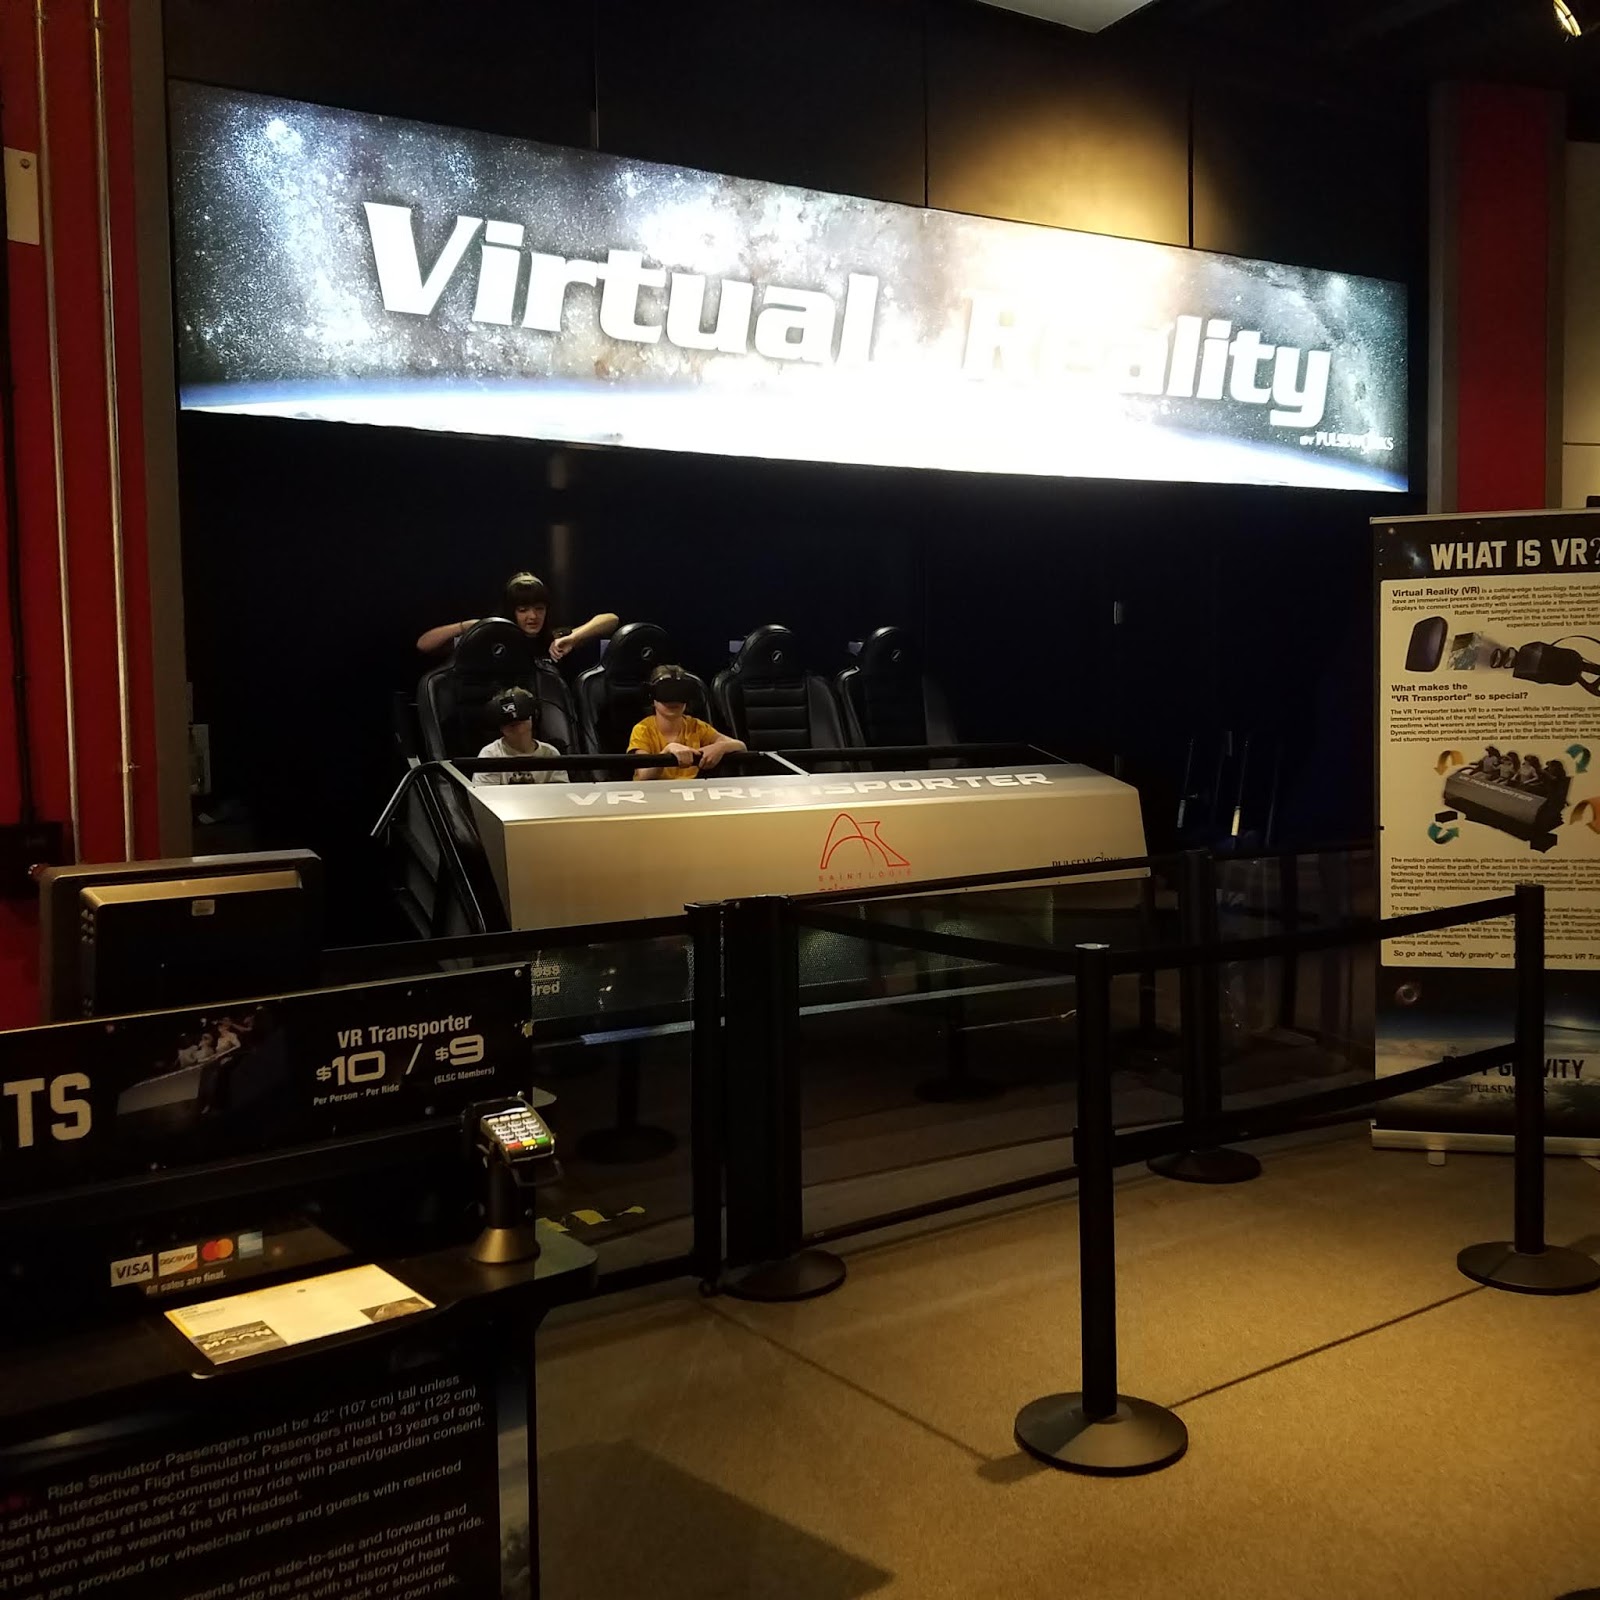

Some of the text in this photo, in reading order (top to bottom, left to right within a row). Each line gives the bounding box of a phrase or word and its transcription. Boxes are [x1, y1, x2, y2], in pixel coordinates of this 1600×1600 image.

[363, 201, 1331, 427] Virtual Reality
[1430, 537, 1600, 570] WHAT IS VR?
[1392, 586, 1480, 597] Virtual Reality (VR)
[1391, 682, 1468, 692] What makes the
[1391, 694, 1409, 702] "VR
[1411, 693, 1472, 702] Transporter"
[1488, 691, 1529, 701] special?
[566, 790, 648, 806] VR
[1417, 950, 1444, 958] ahead,
[1446, 950, 1467, 959] "defy
[1468, 951, 1499, 959] gravity"
[337, 1015, 472, 1049] VR Transporter
[316, 1050, 386, 1086] $10
[435, 1034, 485, 1066] $9
[434, 1066, 495, 1085] (SLSC Members)
[1499, 1059, 1585, 1079] GVITY
[313, 1096, 328, 1106] Per
[329, 1091, 358, 1103] Person
[365, 1088, 380, 1097] Per
[381, 1083, 400, 1094] Ride
[115, 1261, 150, 1279] VISA
[203, 1269, 227, 1282] final.
[48, 1375, 460, 1500] Ride Simulator Passengers must be 42" (107 cm) tall unless
[58, 1484, 140, 1517] Interactive
[145, 1470, 186, 1491] Flight
[190, 1450, 258, 1478] Simulator
[262, 1426, 341, 1458] Passengers
[344, 1414, 376, 1433] must
[380, 1410, 397, 1423] be
[400, 1400, 421, 1416] 48"
[424, 1392, 451, 1413] (122
[454, 1384, 477, 1399] cm)
[36, 1500, 149, 1541] Manufacturers
[153, 1471, 239, 1507] recommend
[243, 1463, 270, 1480] that
[274, 1452, 312, 1472] users
[315, 1446, 333, 1460] be
[336, 1440, 349, 1454] at
[352, 1429, 383, 1449] least
[387, 1423, 402, 1438] 13
[406, 1414, 440, 1435] years
[443, 1407, 455, 1420] of
[458, 1402, 484, 1417] age.
[31, 1545, 49, 1562] 13
[53, 1537, 88, 1555] who
[91, 1528, 117, 1544] are
[120, 1521, 135, 1536] at
[139, 1508, 174, 1530] least
[208, 1491, 229, 1510] tall
[233, 1484, 263, 1502] may
[266, 1475, 294, 1492] ride
[297, 1464, 325, 1482] with
[328, 1434, 431, 1475] parent/guardian
[433, 1416, 485, 1441] consent.
[38, 1558, 78, 1579] worn
[82, 1545, 123, 1566] while
[126, 1524, 186, 1552] wearing
[190, 1516, 213, 1534] the
[217, 1506, 238, 1524] VR
[78, 1559, 145, 1595] provided
[149, 1552, 171, 1569] for
[174, 1528, 251, 1561] wheelchair
[255, 1515, 294, 1536] users
[297, 1504, 322, 1523] and
[326, 1491, 370, 1517] guests
[373, 1480, 400, 1498] with
[404, 1460, 462, 1489] restricted
[239, 1502, 467, 1588] from side-to-side and forwards and
[269, 1581, 291, 1596] the
[294, 1565, 335, 1587] safety
[339, 1559, 361, 1574] bar
[363, 1531, 432, 1565] throughout
[436, 1525, 455, 1540] the
[458, 1515, 484, 1532] ride.
[312, 1580, 341, 1599] with
[344, 1577, 352, 1588] a
[355, 1561, 399, 1584] history
[402, 1553, 415, 1568] of
[418, 1542, 450, 1562] heart
[376, 1582, 389, 1594] or
[393, 1561, 446, 1589] shoulder
